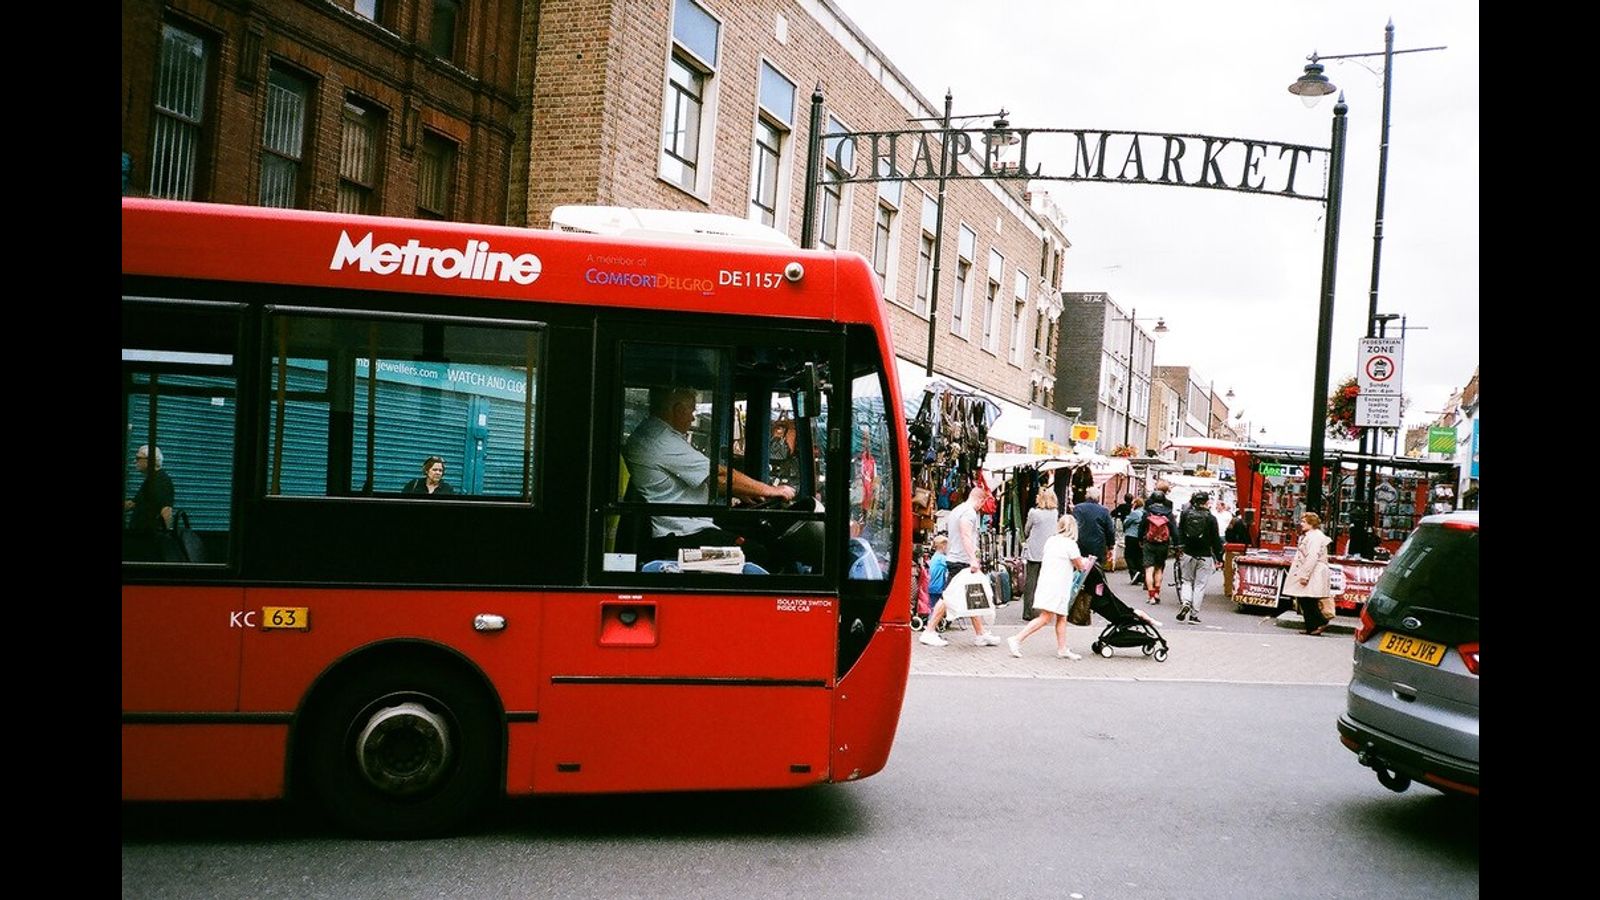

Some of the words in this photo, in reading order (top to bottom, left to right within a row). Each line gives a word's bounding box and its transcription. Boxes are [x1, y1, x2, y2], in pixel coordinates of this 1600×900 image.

[835, 129, 1042, 178] CHAPEL
[1074, 132, 1312, 195] MARKET
[329, 229, 543, 285] Metroline
[596, 255, 634, 266] member
[719, 270, 783, 288] DE1157
[447, 368, 485, 386] WATCH
[487, 376, 506, 389] AND
[776, 598, 807, 606] ISOLATOR
[229, 611, 256, 627] KC
[272, 610, 296, 626] 63
[1386, 635, 1413, 654] BT13
[1412, 643, 1438, 661] JVR
